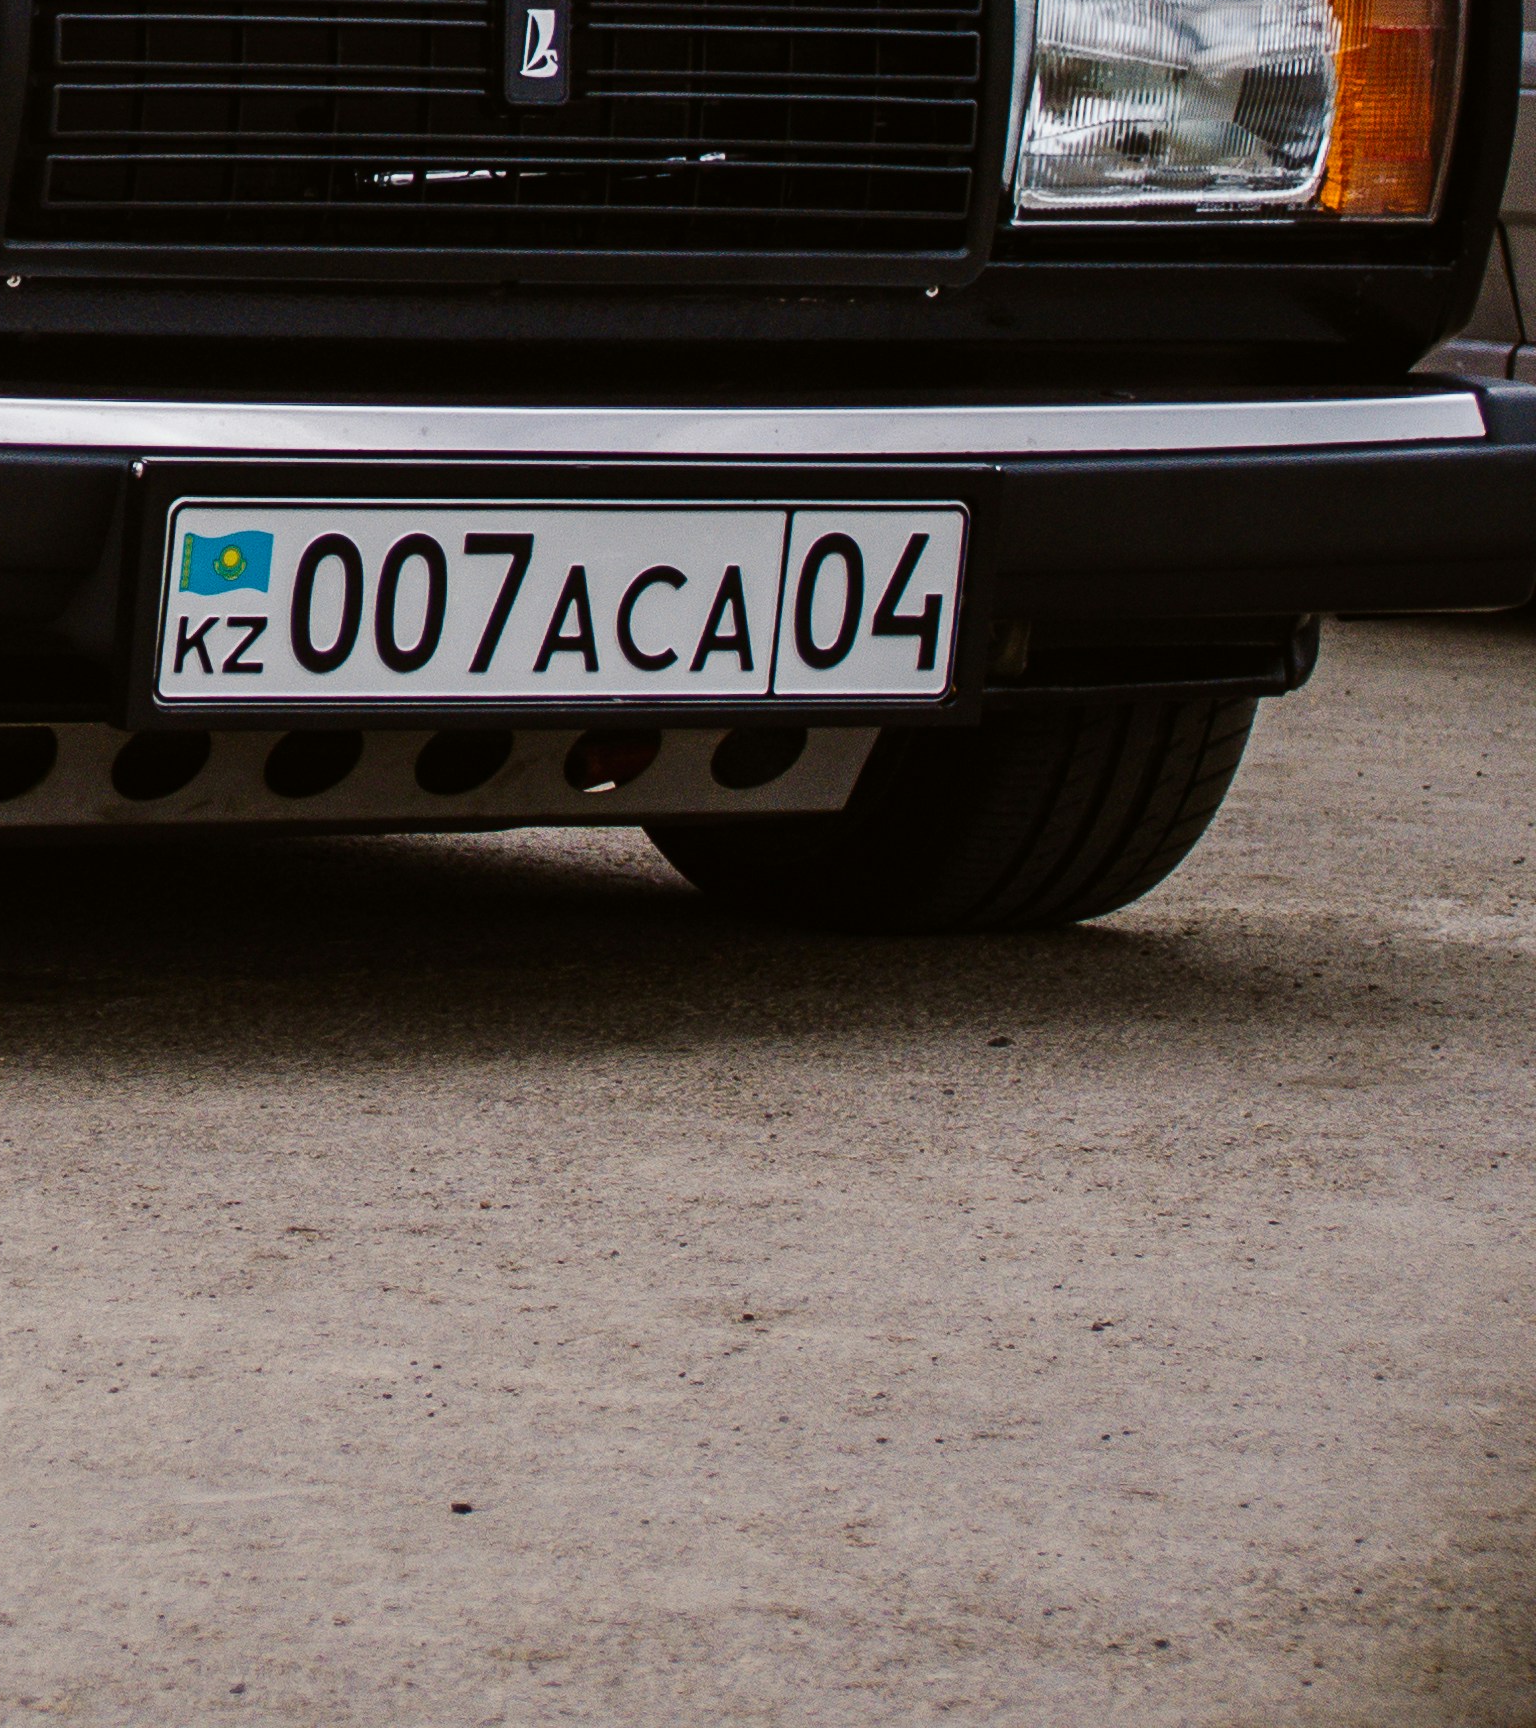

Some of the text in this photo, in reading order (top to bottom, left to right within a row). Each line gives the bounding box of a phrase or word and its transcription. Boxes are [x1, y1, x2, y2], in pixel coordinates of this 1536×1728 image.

[173, 615, 268, 673] KZ
[290, 531, 943, 673] 007ACA 04
